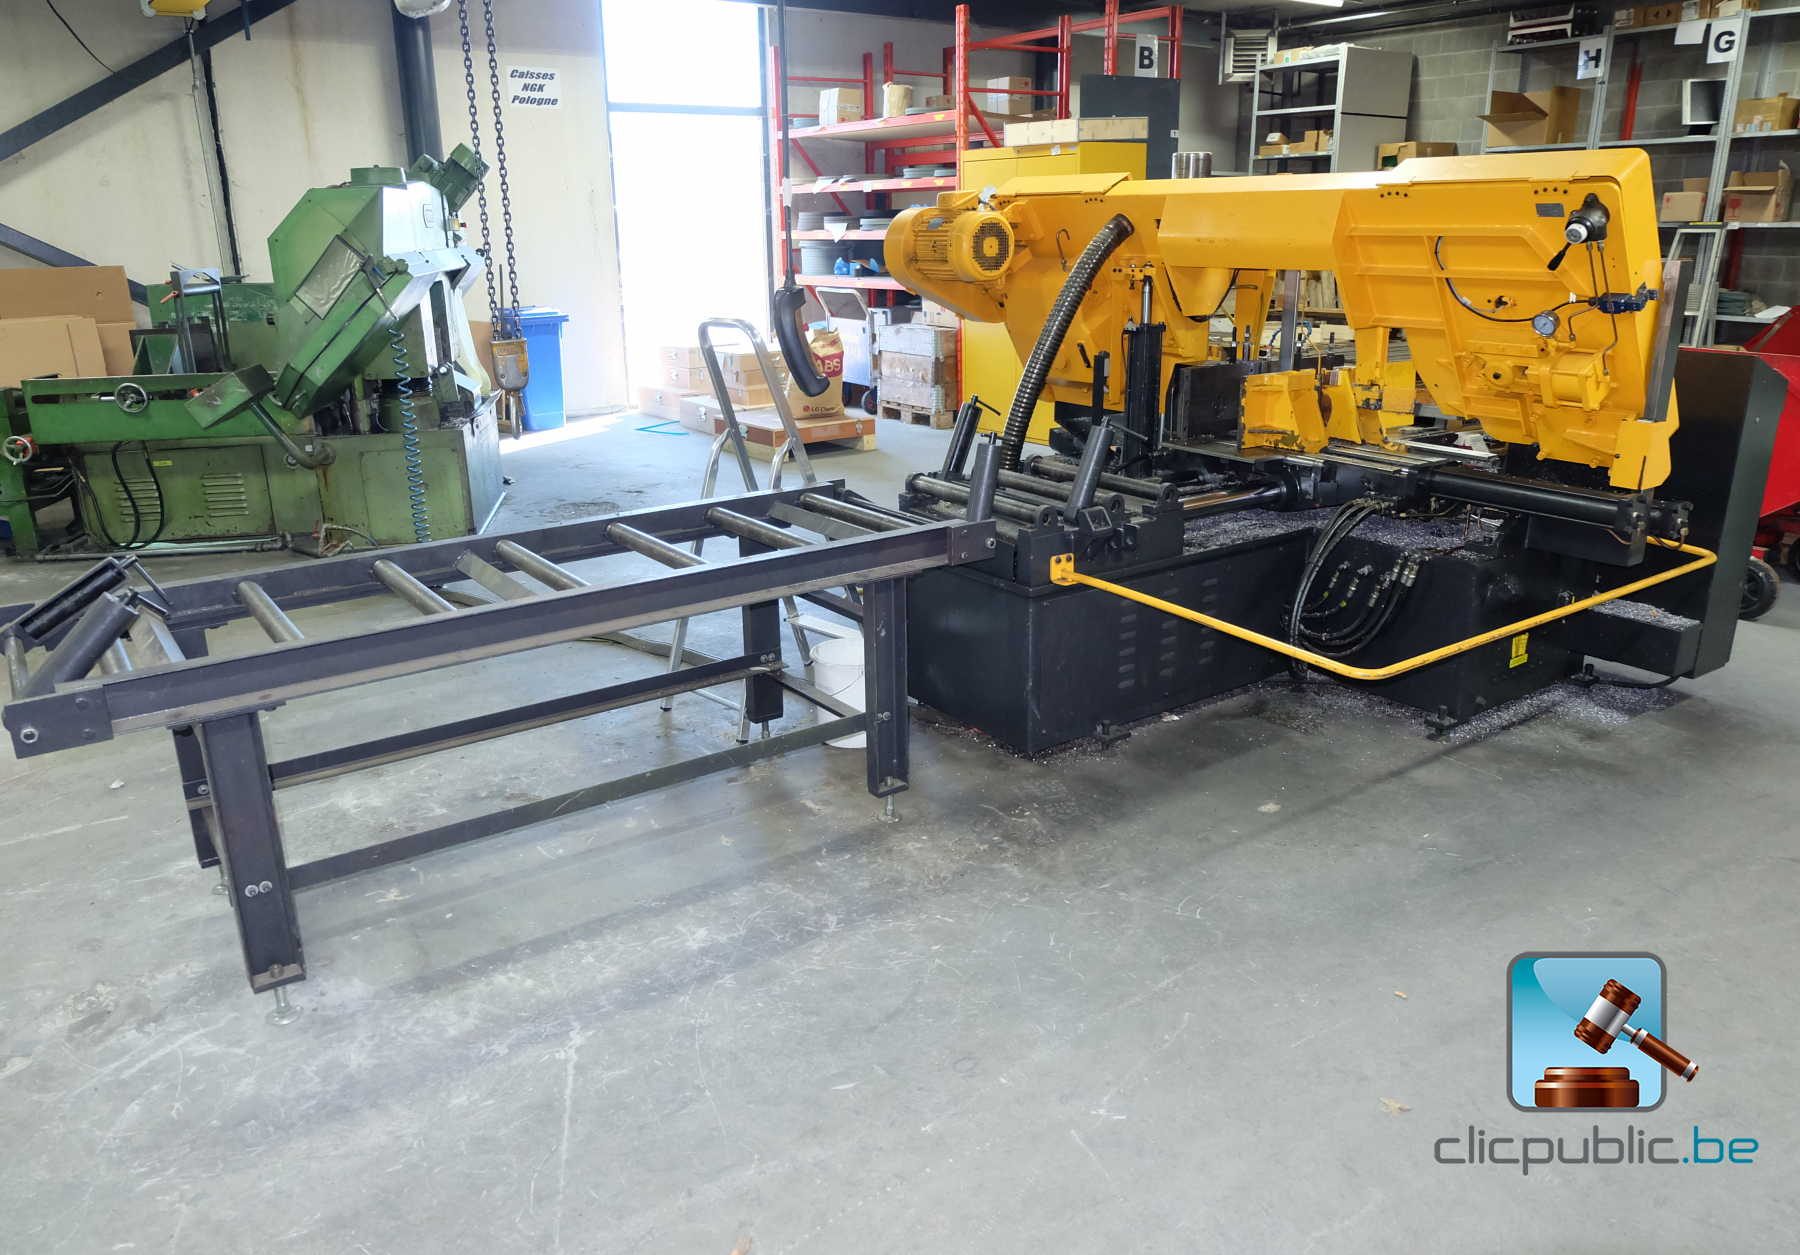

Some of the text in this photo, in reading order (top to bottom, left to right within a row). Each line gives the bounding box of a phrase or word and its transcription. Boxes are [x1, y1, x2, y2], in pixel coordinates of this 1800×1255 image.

[1713, 30, 1736, 53] G
[1138, 46, 1154, 69] B
[1583, 48, 1602, 70] H
[510, 69, 555, 80] Caisses
[521, 83, 546, 92] NGK
[511, 95, 558, 106] Pologne
[816, 359, 840, 372] ABS
